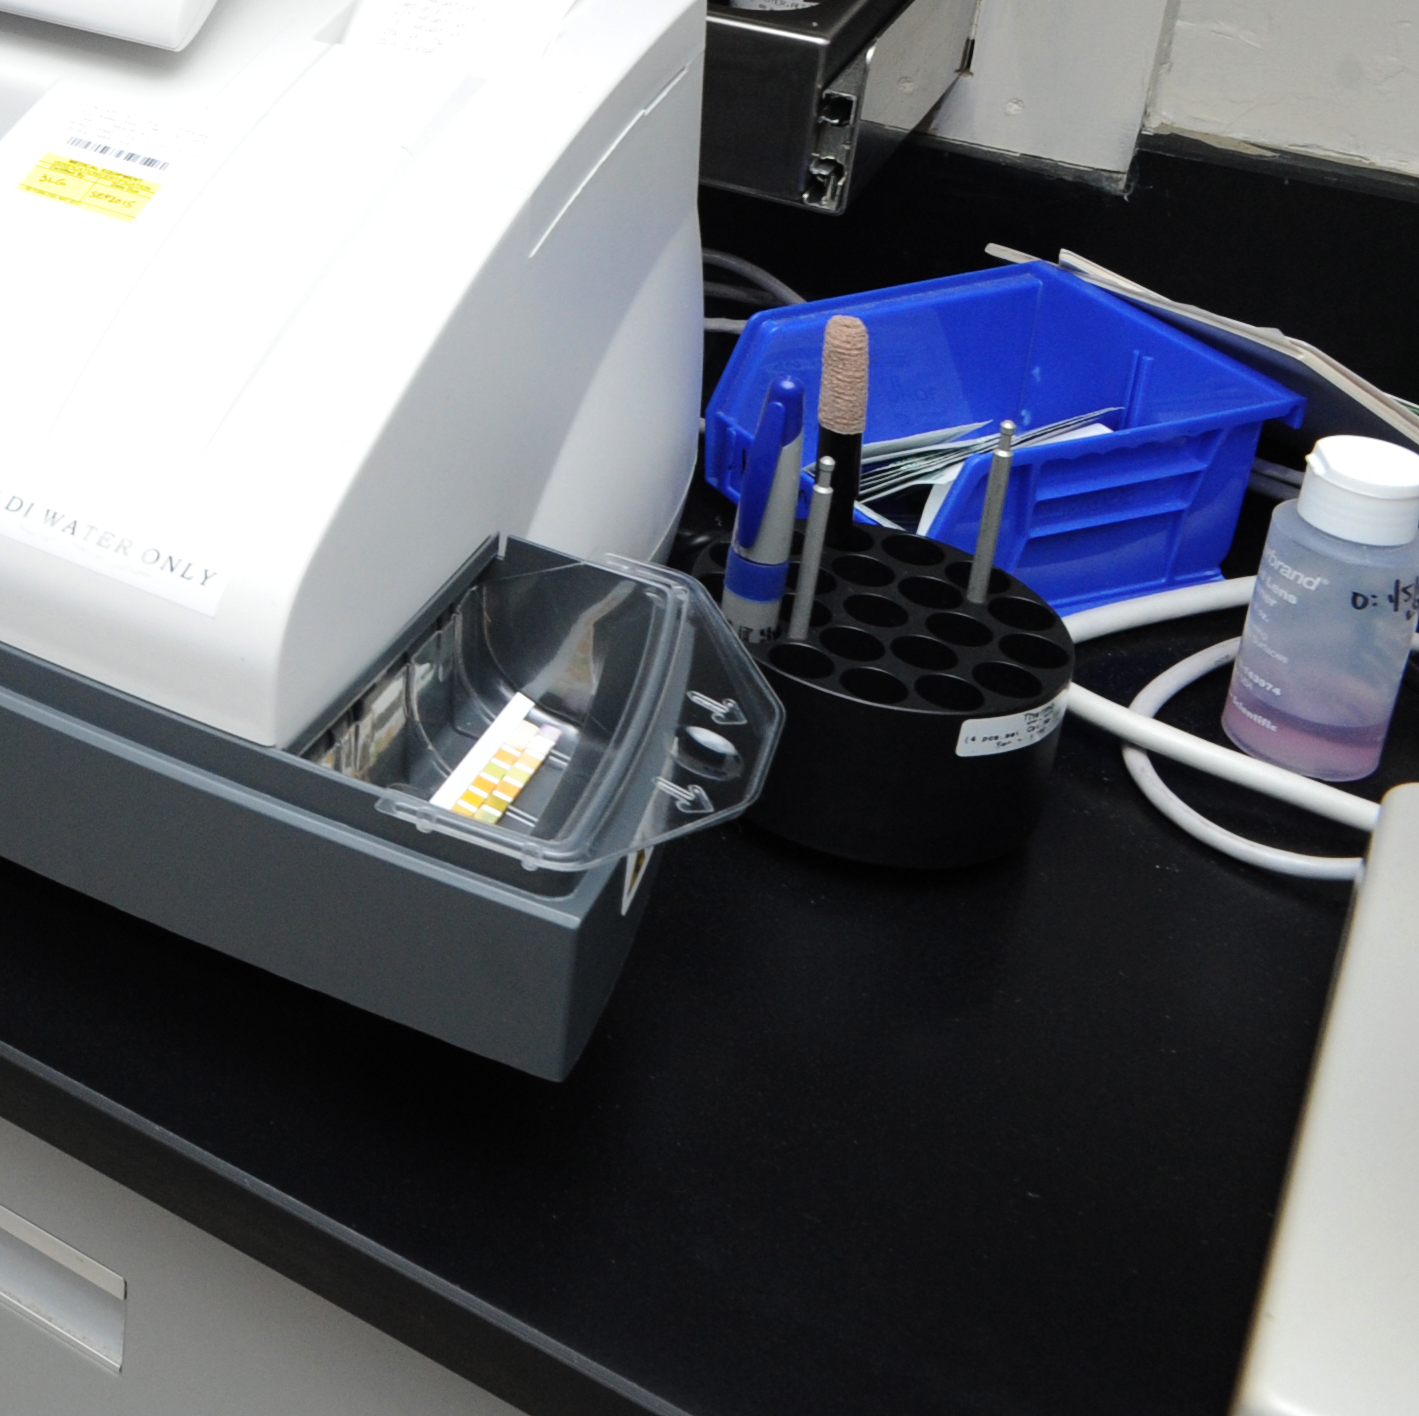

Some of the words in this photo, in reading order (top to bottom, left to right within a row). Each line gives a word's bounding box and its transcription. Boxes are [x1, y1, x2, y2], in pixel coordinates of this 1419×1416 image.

[4, 495, 35, 518] DI
[42, 507, 133, 557] WATER
[141, 547, 218, 587] ONLY
